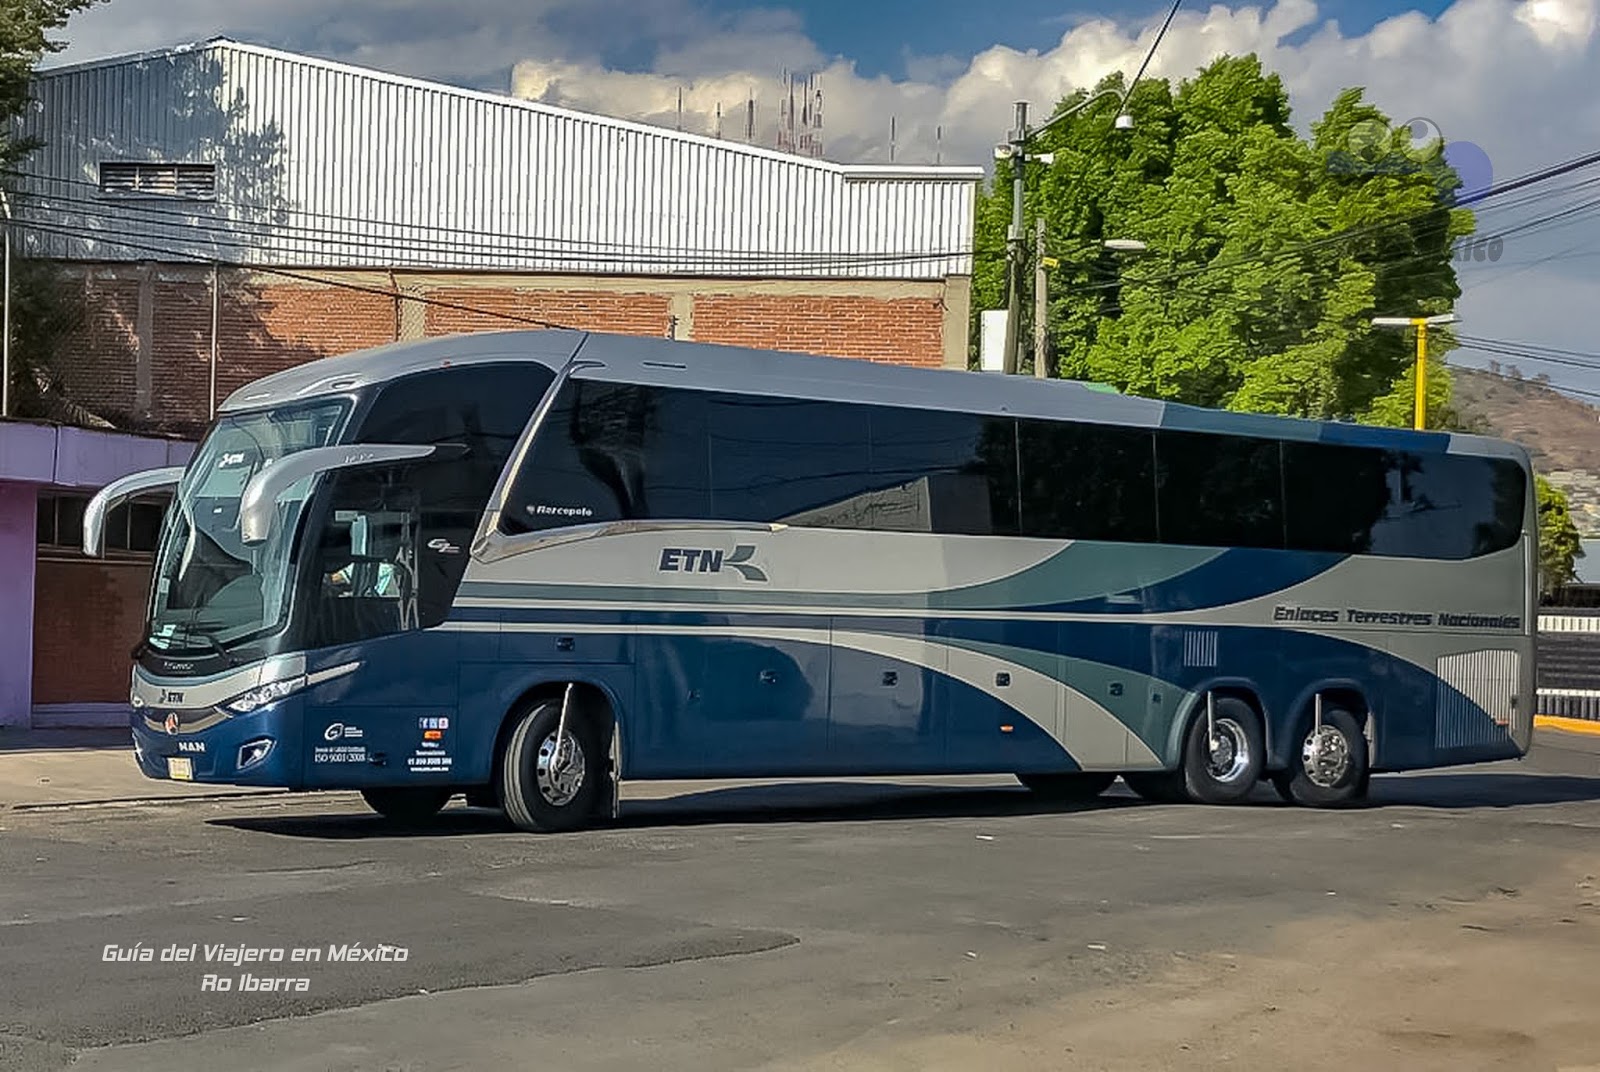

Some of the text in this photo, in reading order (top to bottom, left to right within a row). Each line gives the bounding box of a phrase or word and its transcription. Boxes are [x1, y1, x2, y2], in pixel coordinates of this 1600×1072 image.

[659, 548, 723, 574] ETN
[1273, 606, 1521, 629] Enlaces Terrestres Nacionales
[167, 692, 185, 703] ETN
[314, 753, 329, 763] ISO
